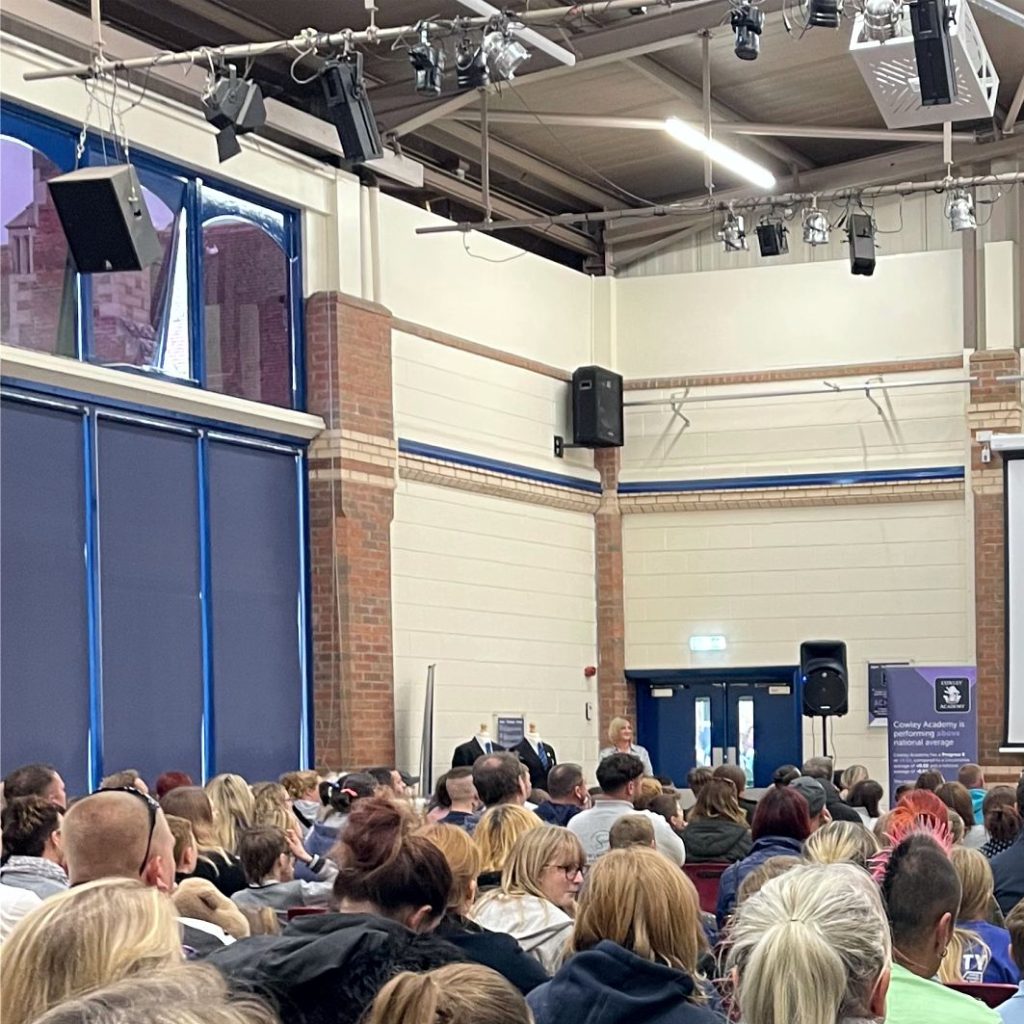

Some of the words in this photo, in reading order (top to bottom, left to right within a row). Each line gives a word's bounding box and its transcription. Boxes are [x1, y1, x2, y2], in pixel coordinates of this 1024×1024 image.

[893, 720, 921, 729] Cowley
[923, 721, 957, 729] Academy
[893, 730, 935, 738] performing
